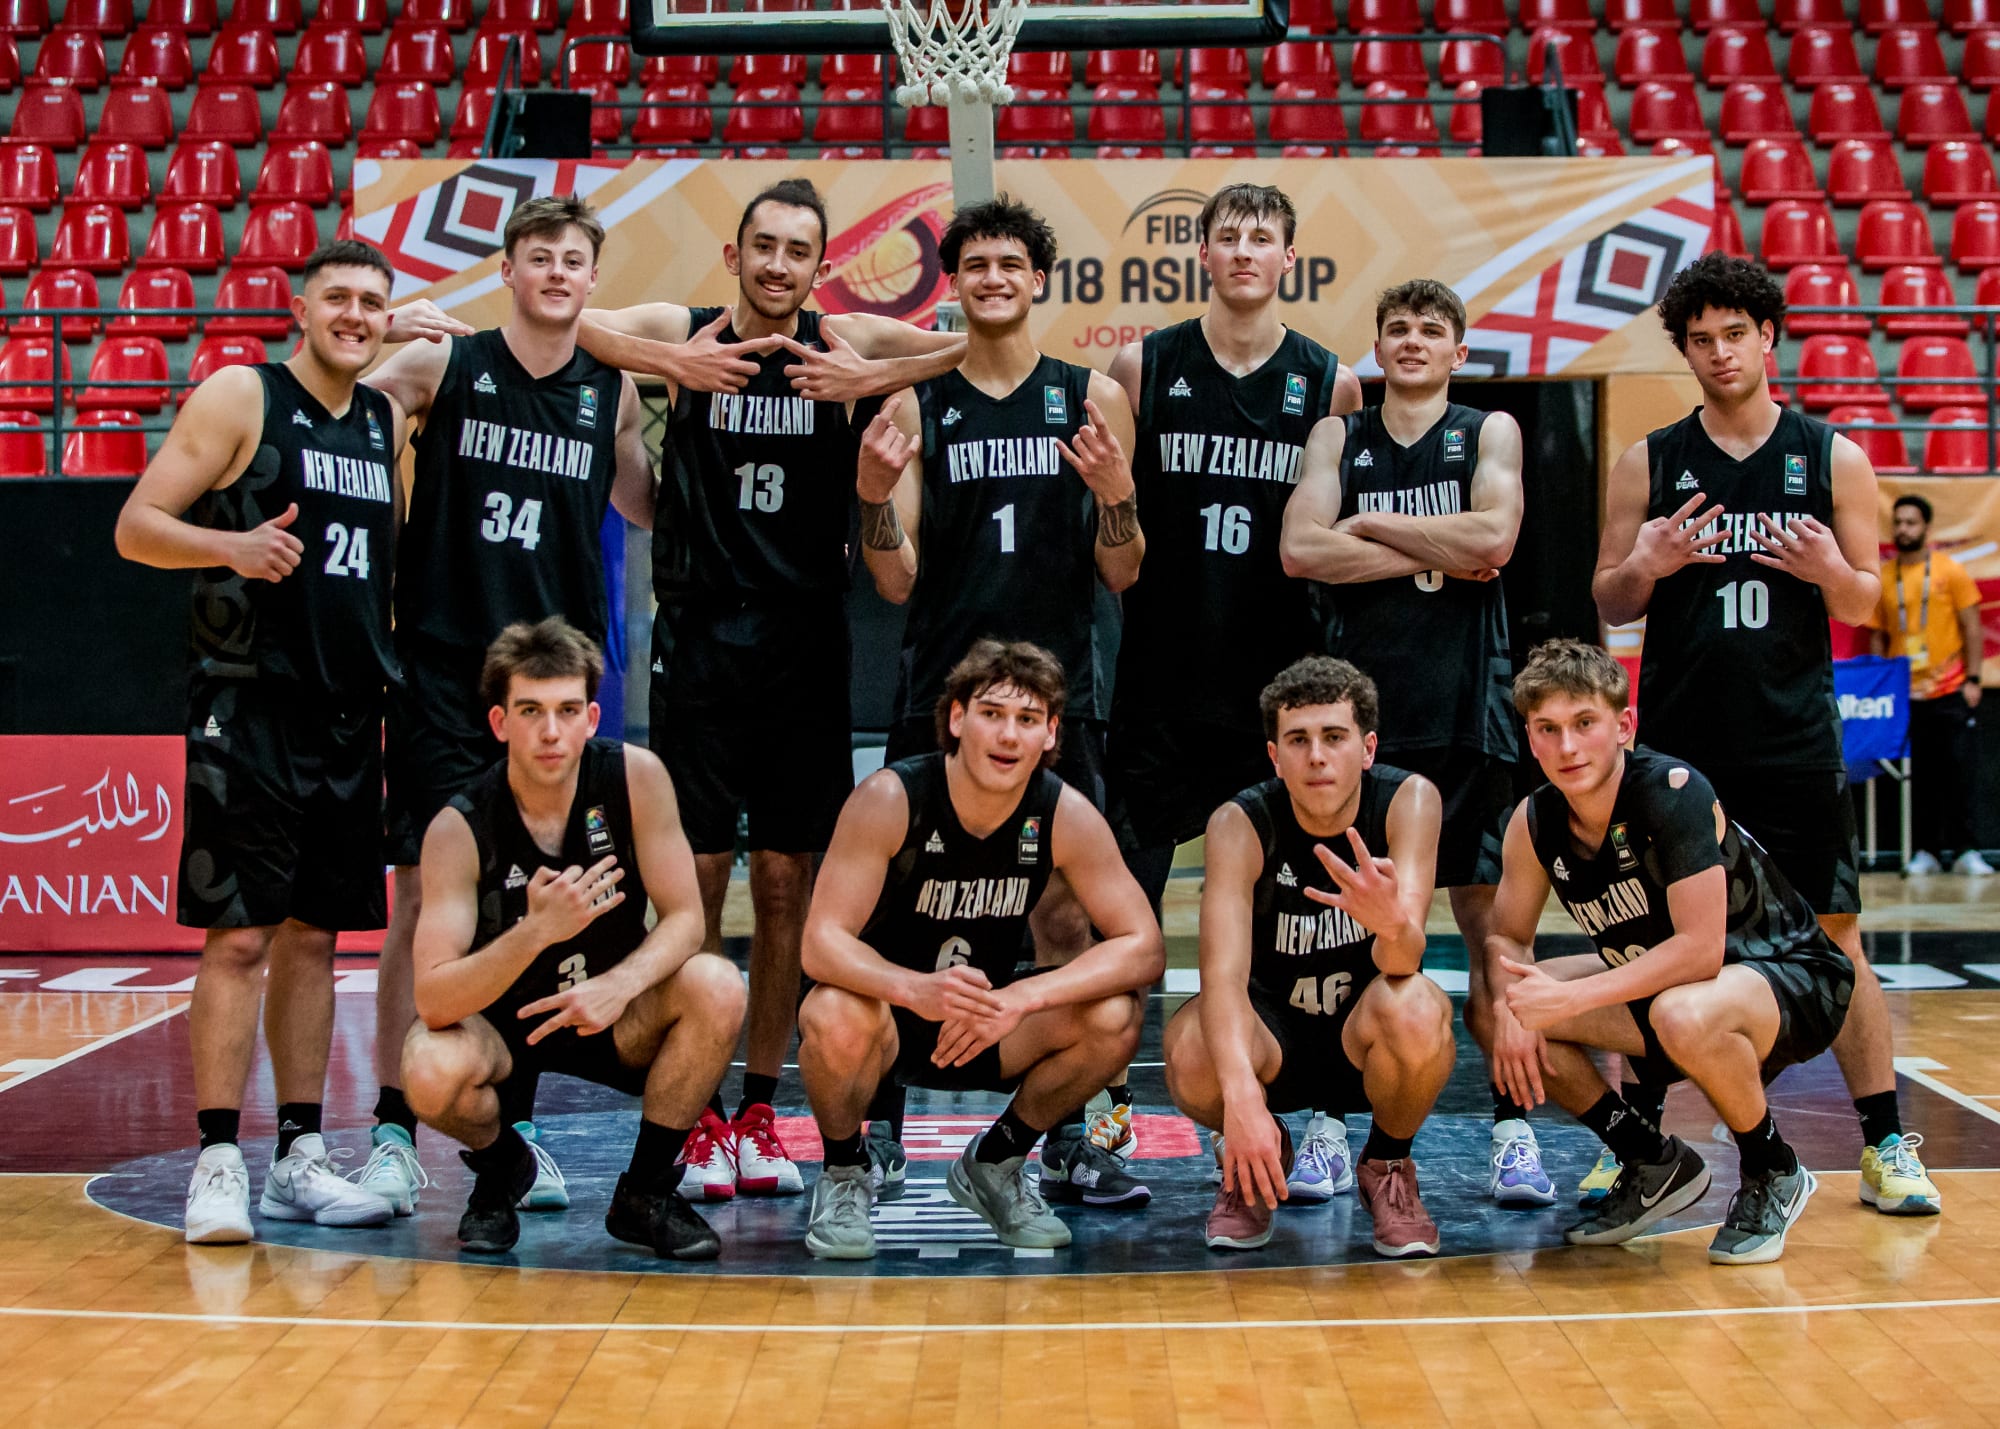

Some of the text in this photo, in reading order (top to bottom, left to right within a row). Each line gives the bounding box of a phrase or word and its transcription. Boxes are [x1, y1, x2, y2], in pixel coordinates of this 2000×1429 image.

[1146, 215, 1206, 245] FIB
[709, 392, 815, 435] NEW ZEALAND
[1169, 387, 1193, 397] PEAK
[458, 418, 594, 481] NEW ZEALAND
[947, 436, 1060, 483] NEW ZEALAND
[1160, 432, 1305, 485] NEW ZEALAND
[301, 448, 391, 504] NEW ZEALAND
[734, 461, 785, 513] 13
[1675, 479, 1700, 491] PEAK
[480, 490, 543, 551] 34
[992, 503, 1015, 552] 1
[1200, 503, 1252, 555] 16
[324, 522, 370, 580] 24
[1716, 580, 1769, 629] 10
[0, 875, 168, 915] ANIAN
[915, 877, 1030, 921] NEW ZEALAND
[1275, 911, 1316, 956] NEW
[558, 953, 588, 993] 3
[1289, 971, 1352, 1016] 46
